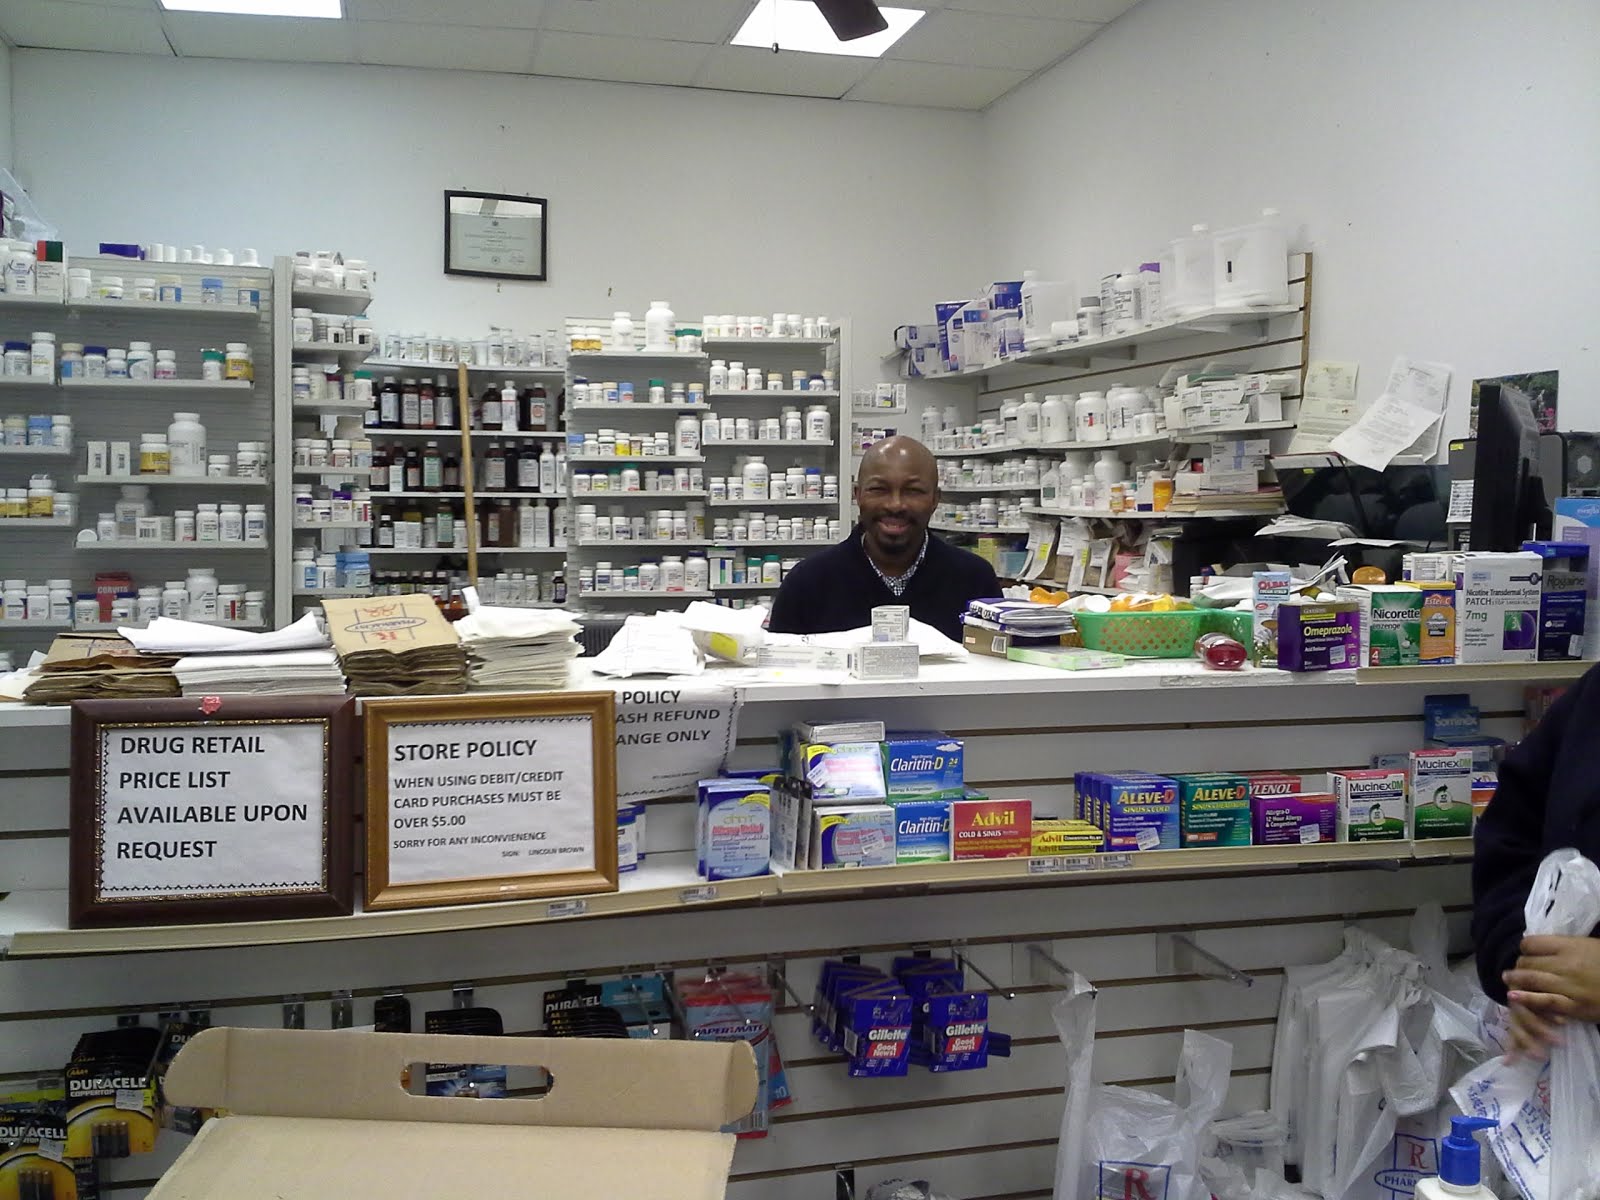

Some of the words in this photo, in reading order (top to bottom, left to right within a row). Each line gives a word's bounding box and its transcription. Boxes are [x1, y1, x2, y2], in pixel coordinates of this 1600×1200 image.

[1466, 589, 1489, 597] Nicotine
[1490, 588, 1521, 596] Transdermal
[1522, 588, 1540, 598] System
[1465, 597, 1492, 606] PATCH
[1373, 608, 1420, 619] Nicorette
[1465, 610, 1488, 622] 7mg
[1303, 623, 1353, 638] Omeprazole
[1371, 650, 1379, 659] 4
[622, 690, 681, 704] POLICY
[616, 712, 648, 724] ASH
[654, 709, 721, 722] REFUND
[1434, 716, 1478, 727] Sominex
[121, 737, 185, 754] DRUG
[192, 736, 266, 753] RETAIL
[616, 733, 662, 746] ANGE
[666, 730, 711, 742] ONLY
[394, 743, 460, 762] STORE
[467, 740, 538, 758] POLICY
[119, 771, 181, 788] PRICE
[188, 771, 231, 788] LIST
[394, 777, 434, 789] WHEN
[437, 775, 477, 787] USING
[480, 771, 564, 785] DEBIT/CREDIT
[1192, 785, 1247, 802] ALEVE-D
[1250, 783, 1293, 795] YLENOL
[394, 797, 428, 809] CARD
[432, 793, 504, 807] PURCHASES
[508, 791, 543, 803] MUST
[546, 790, 561, 801] BE
[1117, 789, 1175, 805] ALEVE-D
[117, 805, 237, 824] AVAILABLE
[244, 804, 307, 821] UPON
[972, 810, 1015, 827] Advil
[394, 817, 428, 829] OVER
[431, 815, 466, 828] $5.00
[393, 839, 425, 849] SORRY
[427, 838, 447, 847] FOR
[448, 836, 469, 846] ANY
[471, 832, 547, 845] INCONVIENENCE
[959, 831, 976, 839] COLD
[1039, 834, 1062, 843] Advil
[117, 841, 217, 861] REQUEST
[868, 1029, 908, 1041] Gillette
[946, 1023, 984, 1036] Gillette
[877, 1043, 896, 1051] Good
[952, 1043, 975, 1051] News!
[955, 1038, 974, 1046] Good
[873, 1047, 896, 1056] News!
[70, 1077, 147, 1091] DURACELL
[70, 1089, 115, 1098] COPPERTOP
